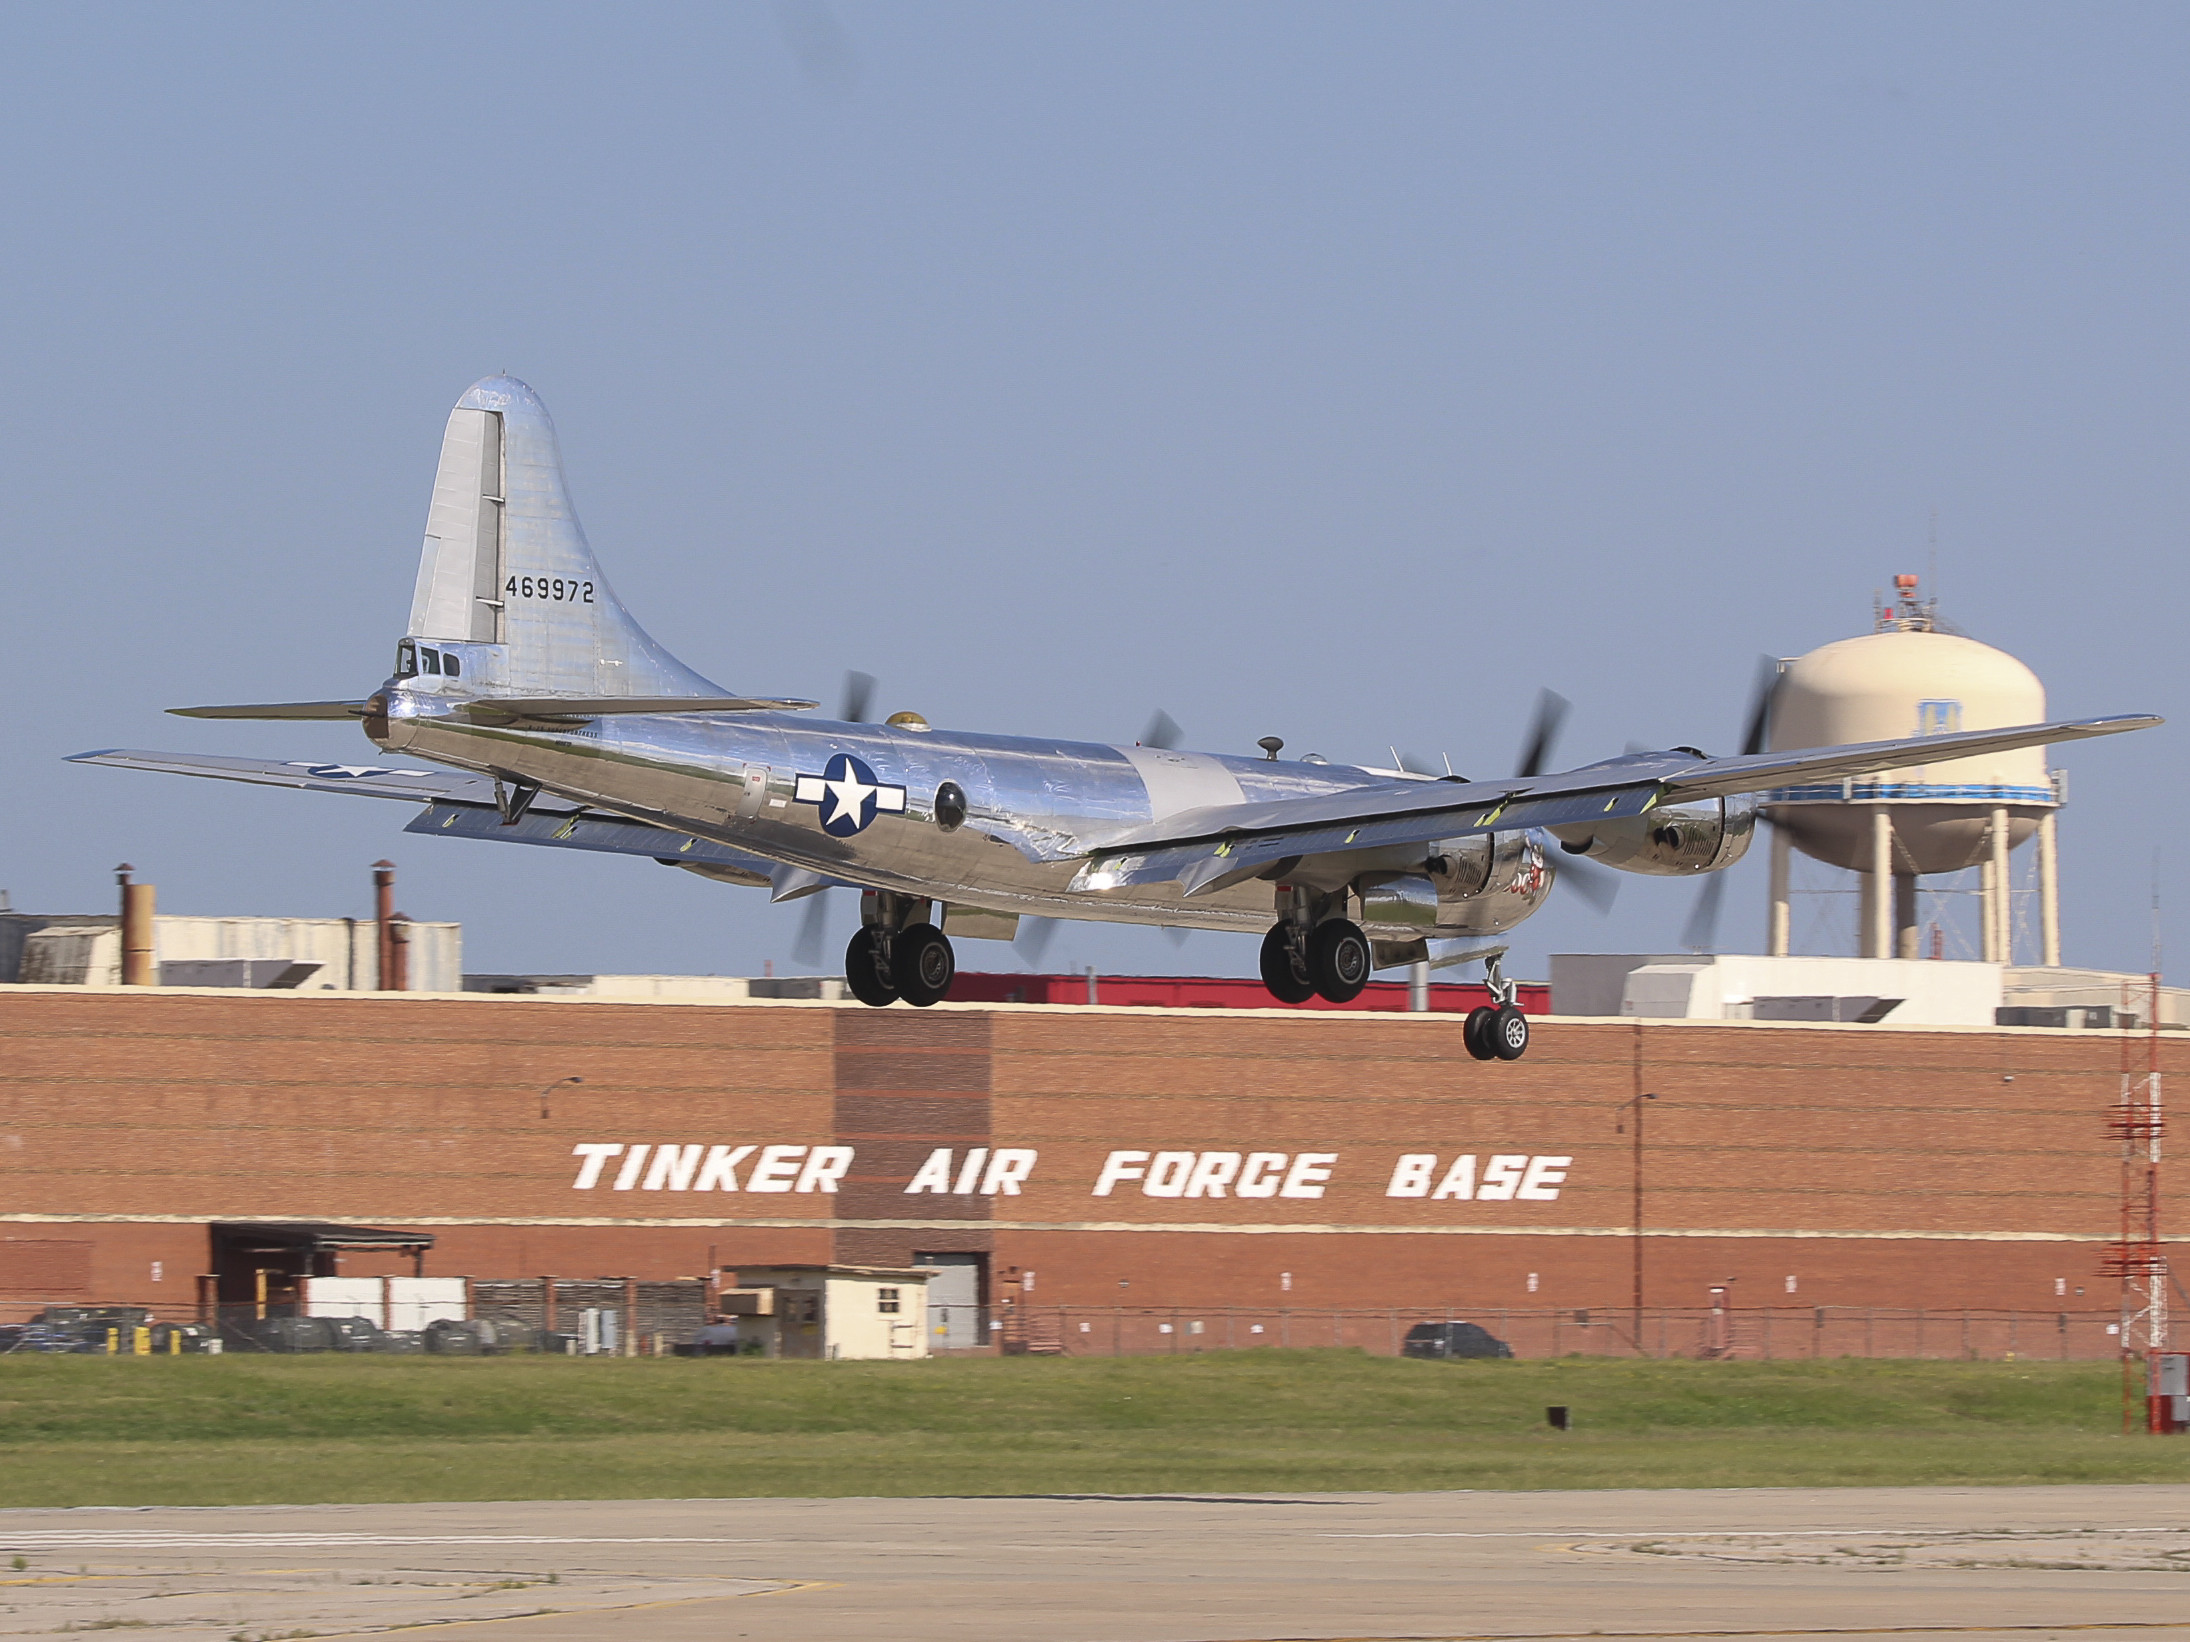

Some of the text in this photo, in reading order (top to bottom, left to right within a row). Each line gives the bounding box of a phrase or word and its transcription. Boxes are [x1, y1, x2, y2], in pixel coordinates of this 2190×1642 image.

[505, 575, 594, 604] 469972
[571, 1143, 1574, 1201] TINKER AIR FORCE BASE
